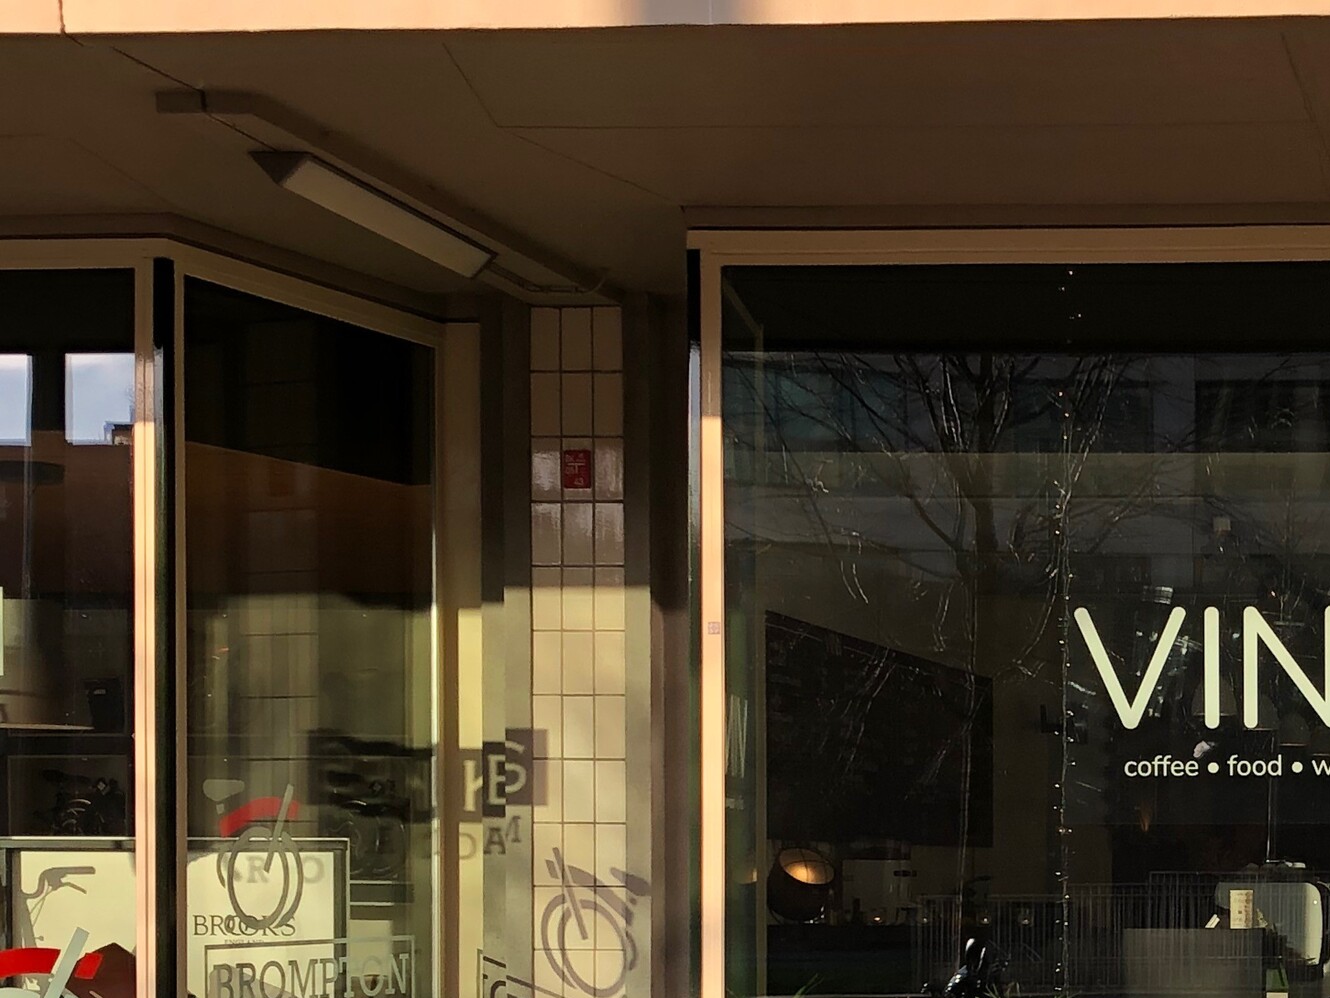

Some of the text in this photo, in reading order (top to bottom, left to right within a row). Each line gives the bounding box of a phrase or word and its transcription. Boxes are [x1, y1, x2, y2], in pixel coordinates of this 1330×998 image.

[1124, 756, 1199, 778] coffee
[1227, 755, 1283, 777] food
[192, 914, 297, 937] BROOKS
